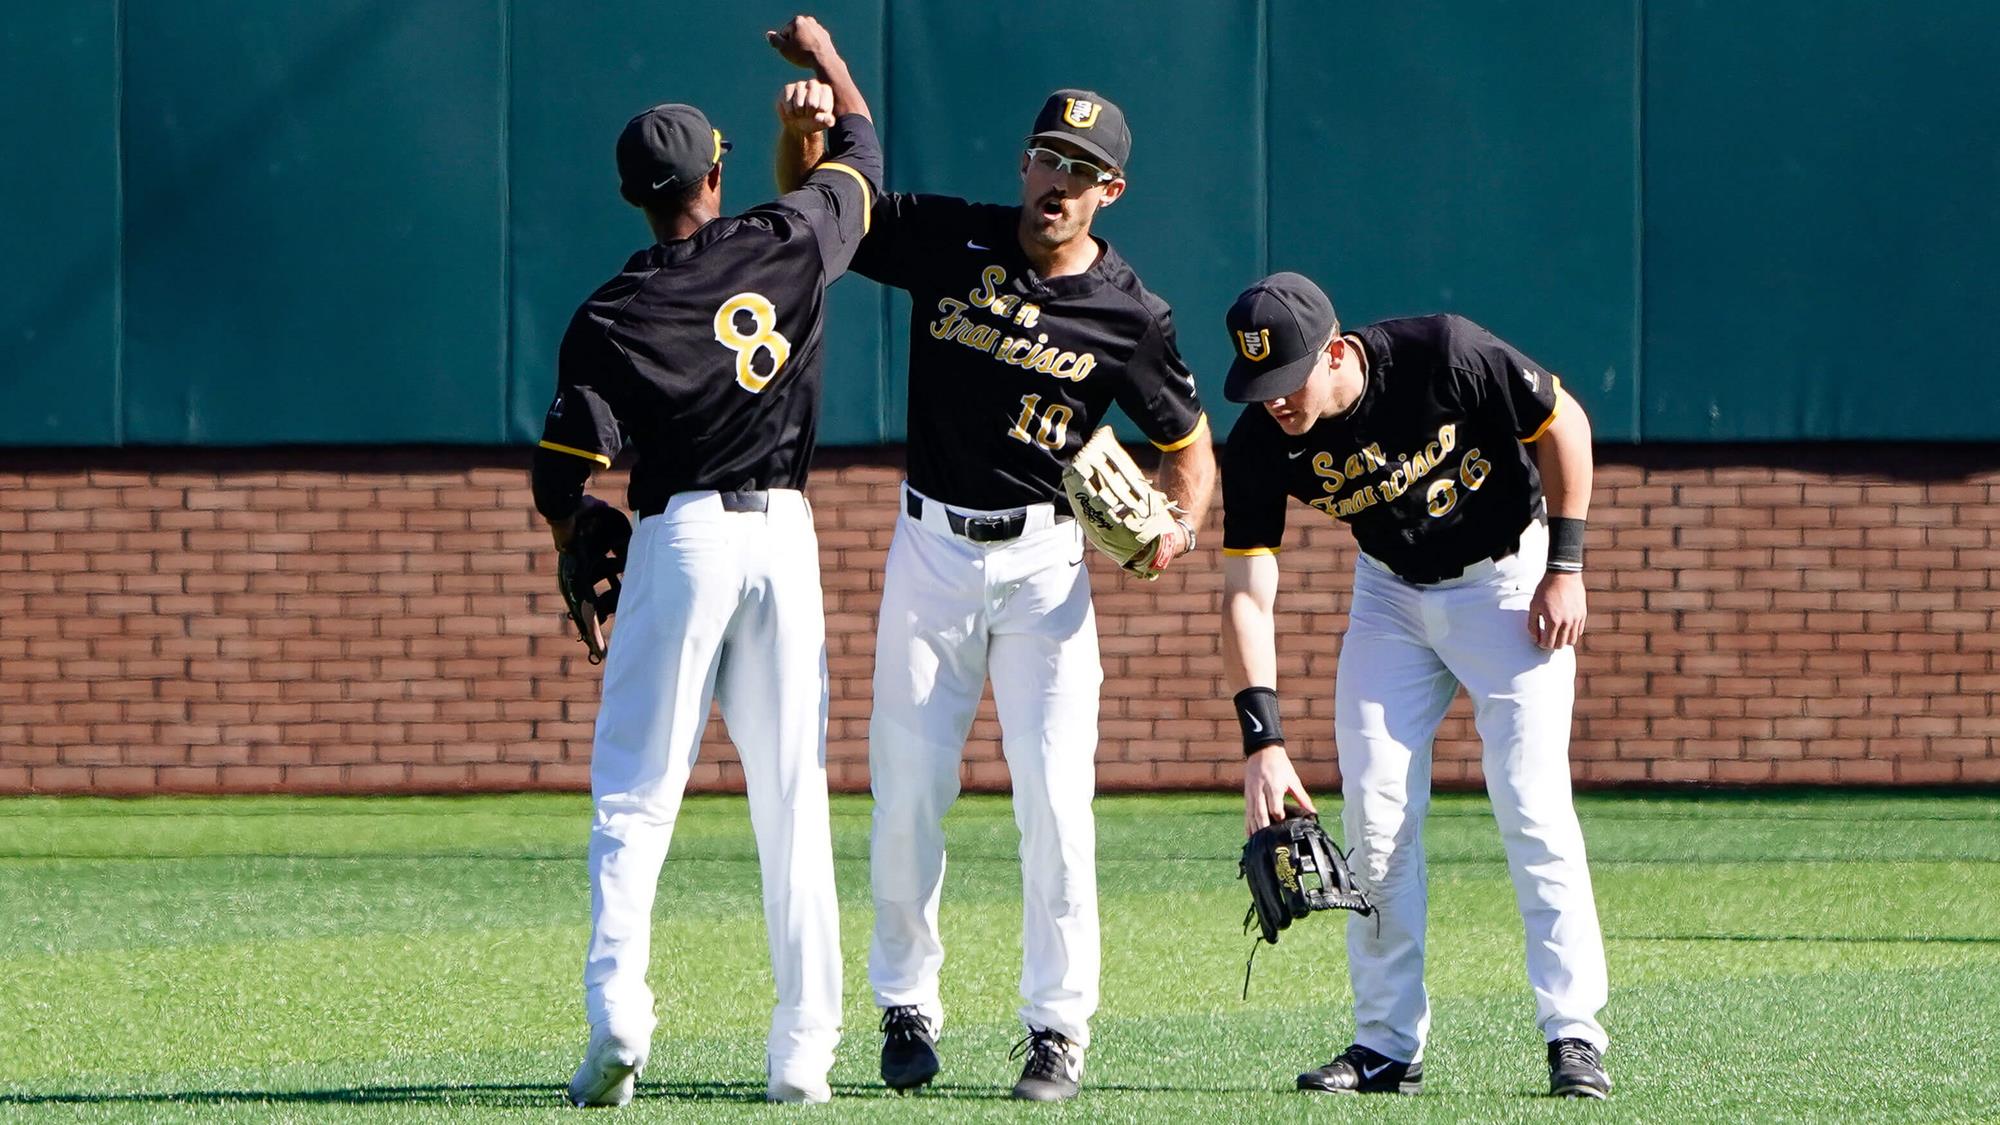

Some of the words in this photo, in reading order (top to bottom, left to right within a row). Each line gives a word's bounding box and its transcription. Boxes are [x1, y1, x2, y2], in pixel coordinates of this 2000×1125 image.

[969, 264, 1041, 328] San
[713, 291, 791, 394] 8
[930, 297, 1097, 382] Francisco
[1007, 393, 1073, 450] 10
[1309, 423, 1456, 519] Francisco
[1312, 442, 1387, 493] San
